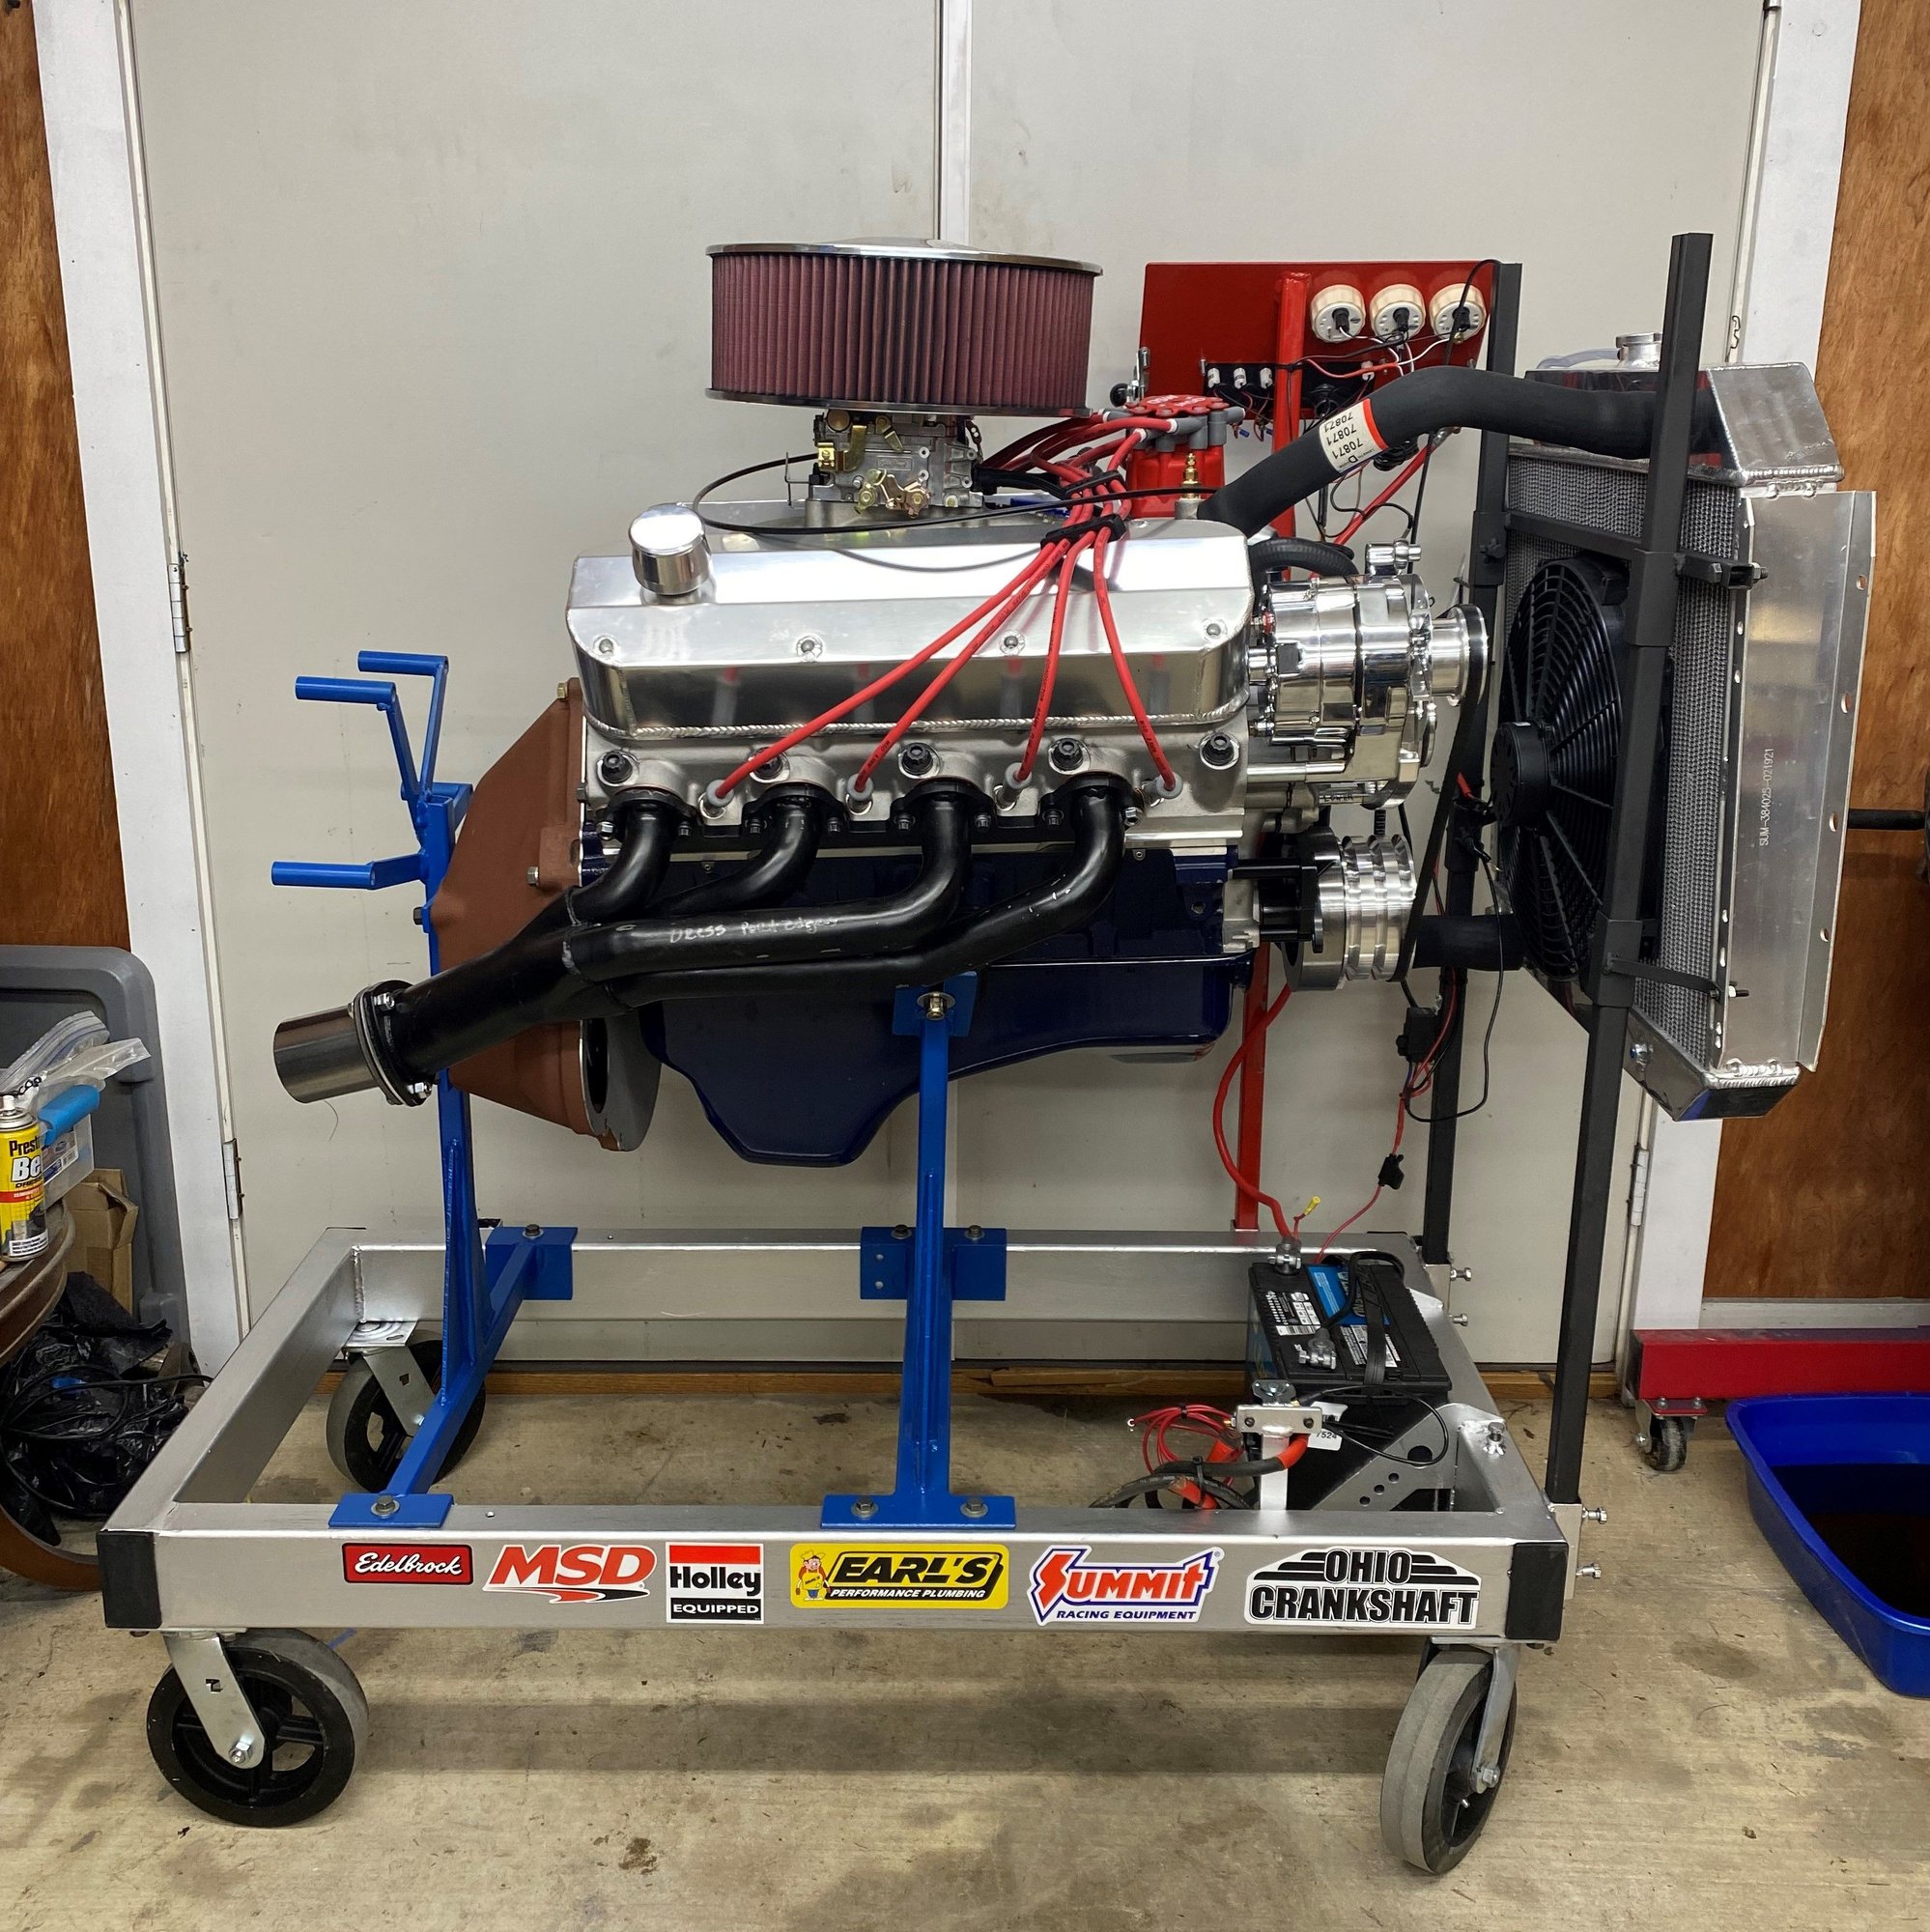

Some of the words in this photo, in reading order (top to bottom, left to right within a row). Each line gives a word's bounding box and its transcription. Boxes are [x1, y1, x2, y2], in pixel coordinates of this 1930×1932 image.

[1324, 412, 1353, 433] 70871
[1326, 423, 1357, 446] 70871
[1332, 438, 1364, 460] 70871
[355, 1551, 463, 1575] Edelbrock
[489, 1546, 656, 1585] MSD
[832, 1556, 993, 1584] EARL'S
[1323, 1548, 1413, 1585] OHIO
[669, 1566, 761, 1597] Holley
[830, 1589, 920, 1598] PERFORMANCE
[922, 1589, 986, 1598] PLUMBING
[1250, 1584, 1480, 1624] CRANKSHAFT
[673, 1604, 759, 1614] EQUIPPED
[1056, 1610, 1110, 1619] RACING
[1113, 1610, 1197, 1620] EQUIPMENT
